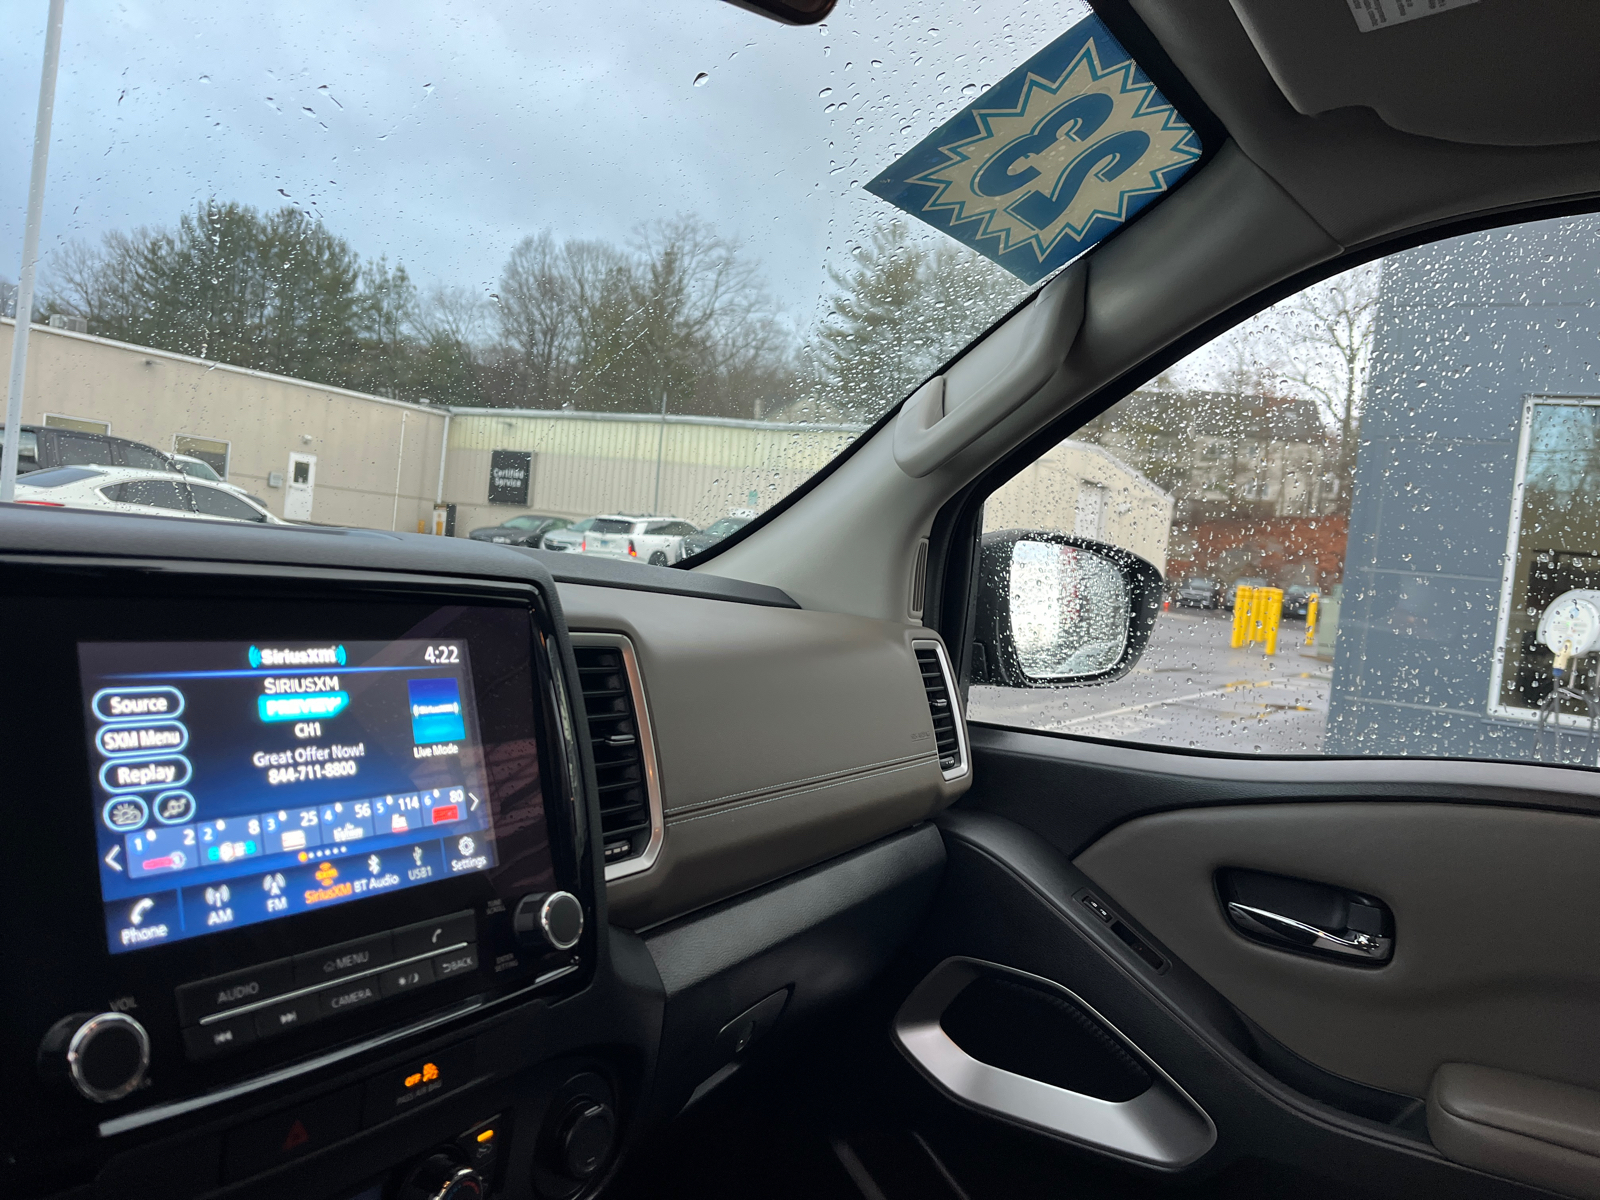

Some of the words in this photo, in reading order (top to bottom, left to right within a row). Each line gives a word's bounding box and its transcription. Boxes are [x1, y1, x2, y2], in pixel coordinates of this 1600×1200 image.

[493, 467, 524, 479] Certified
[494, 477, 521, 488] Service
[424, 645, 460, 664] 4:22
[264, 675, 340, 694] SIRIUSXM
[110, 696, 168, 715] Source
[266, 696, 342, 717] PREVIEW
[294, 722, 322, 739] CH1
[103, 731, 138, 750] SXM
[139, 729, 181, 747] Menu
[253, 748, 293, 767] Great
[294, 745, 330, 763] Offer
[331, 742, 365, 760] Now!
[413, 746, 432, 759] Live
[433, 743, 459, 756] Mode
[117, 763, 176, 786] Replay
[268, 760, 357, 785] 844-711-8800
[398, 796, 420, 811] 114
[423, 795, 432, 807] 6
[449, 789, 464, 803] 80
[323, 810, 333, 822] 4
[354, 803, 371, 818] 56
[376, 802, 385, 814] 5
[248, 818, 260, 835] 8
[266, 818, 276, 831] 3
[300, 811, 318, 826] 25
[183, 828, 196, 846] 2
[203, 828, 213, 841] 2
[134, 838, 143, 852] 1
[451, 855, 487, 872] Settings
[408, 866, 432, 881] USB1
[353, 879, 367, 893] BT
[369, 873, 400, 890] Audio
[304, 882, 353, 904] SiriusXM
[266, 896, 288, 912] FM
[207, 908, 233, 926] AM
[121, 923, 168, 946] Phone
[335, 951, 370, 970] MENU
[451, 955, 474, 972] BACK
[216, 982, 260, 1004] AUDIO
[330, 987, 373, 1009] CAMERA
[108, 996, 137, 1012] VOL
